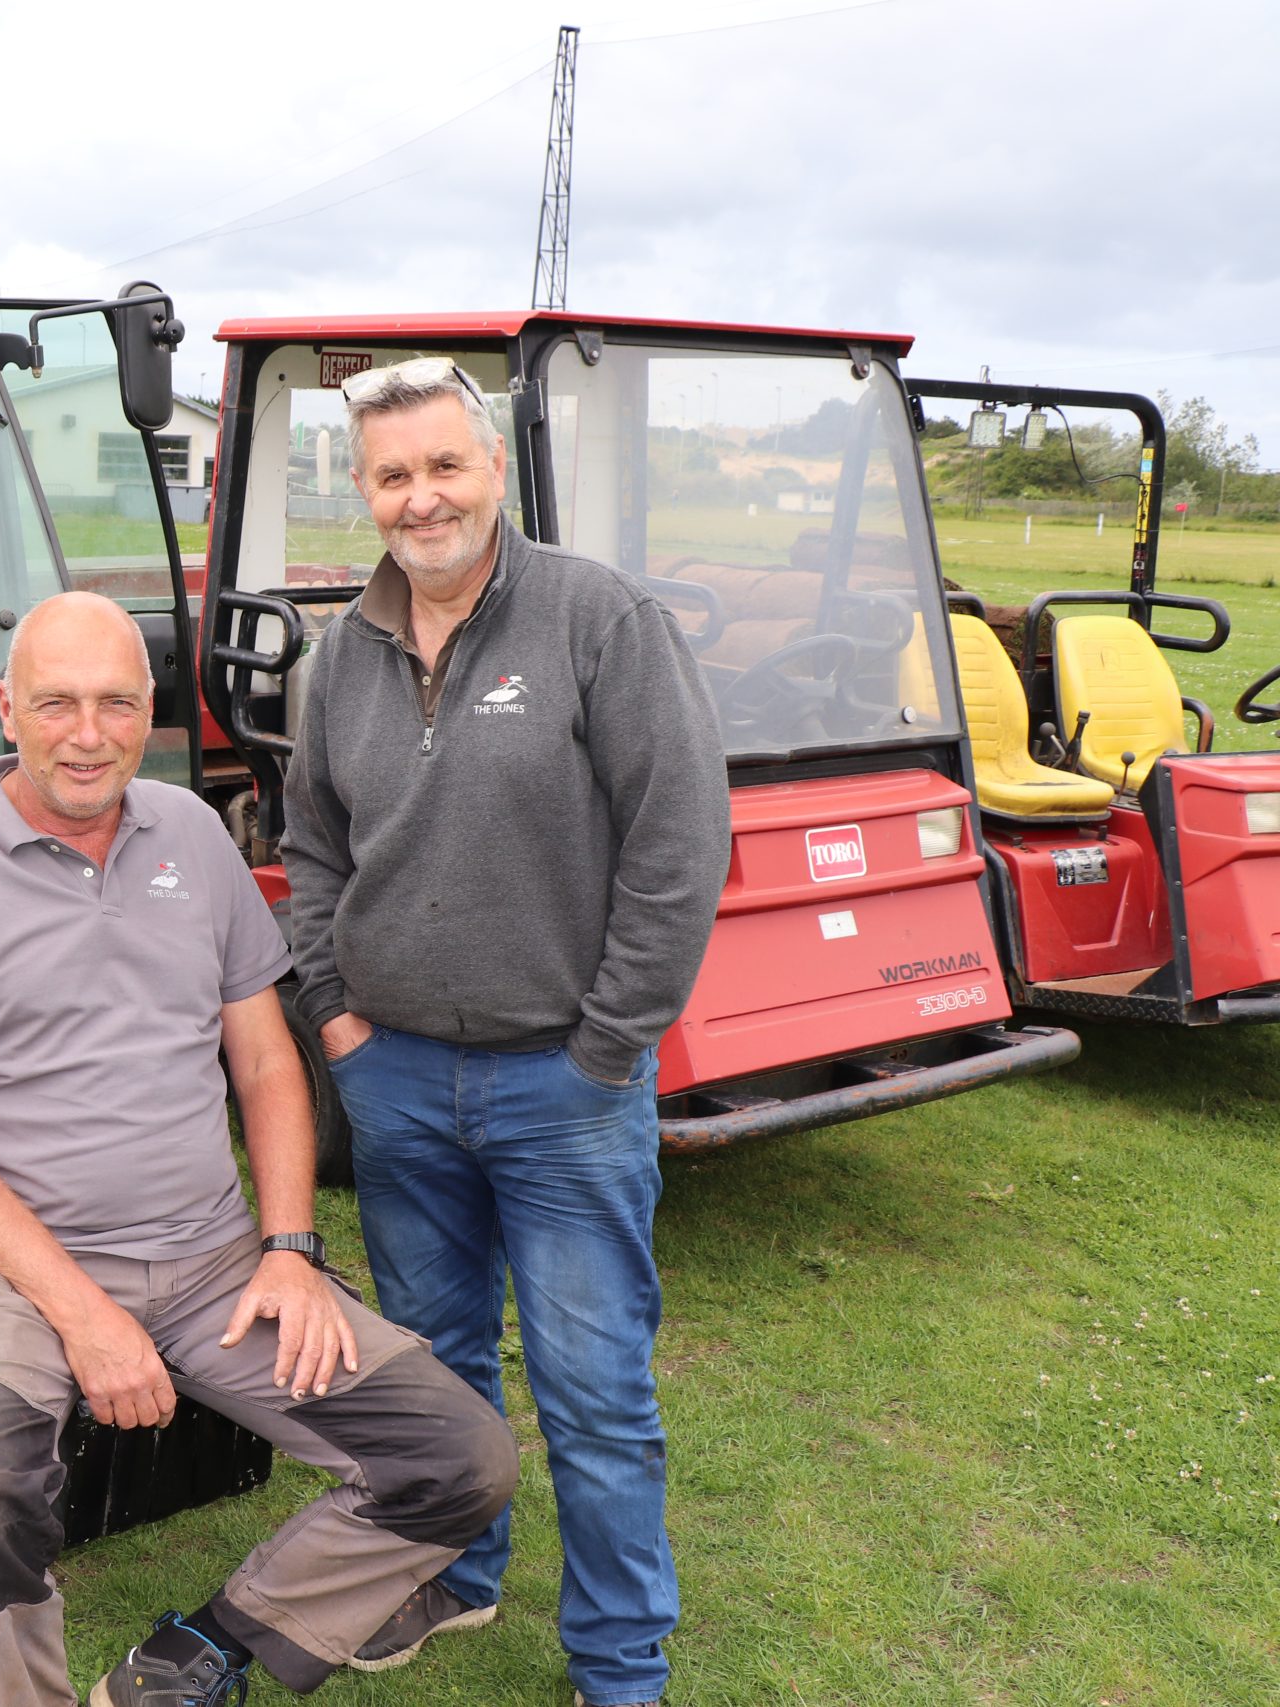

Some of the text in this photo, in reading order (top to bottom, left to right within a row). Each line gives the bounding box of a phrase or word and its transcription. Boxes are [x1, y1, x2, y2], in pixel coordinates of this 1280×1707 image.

[473, 703, 525, 714] THE DUNES
[811, 840, 859, 865] TORO
[147, 889, 165, 898] THE
[878, 951, 982, 983] WORKMAN
[917, 986, 987, 1016] 3300-D
